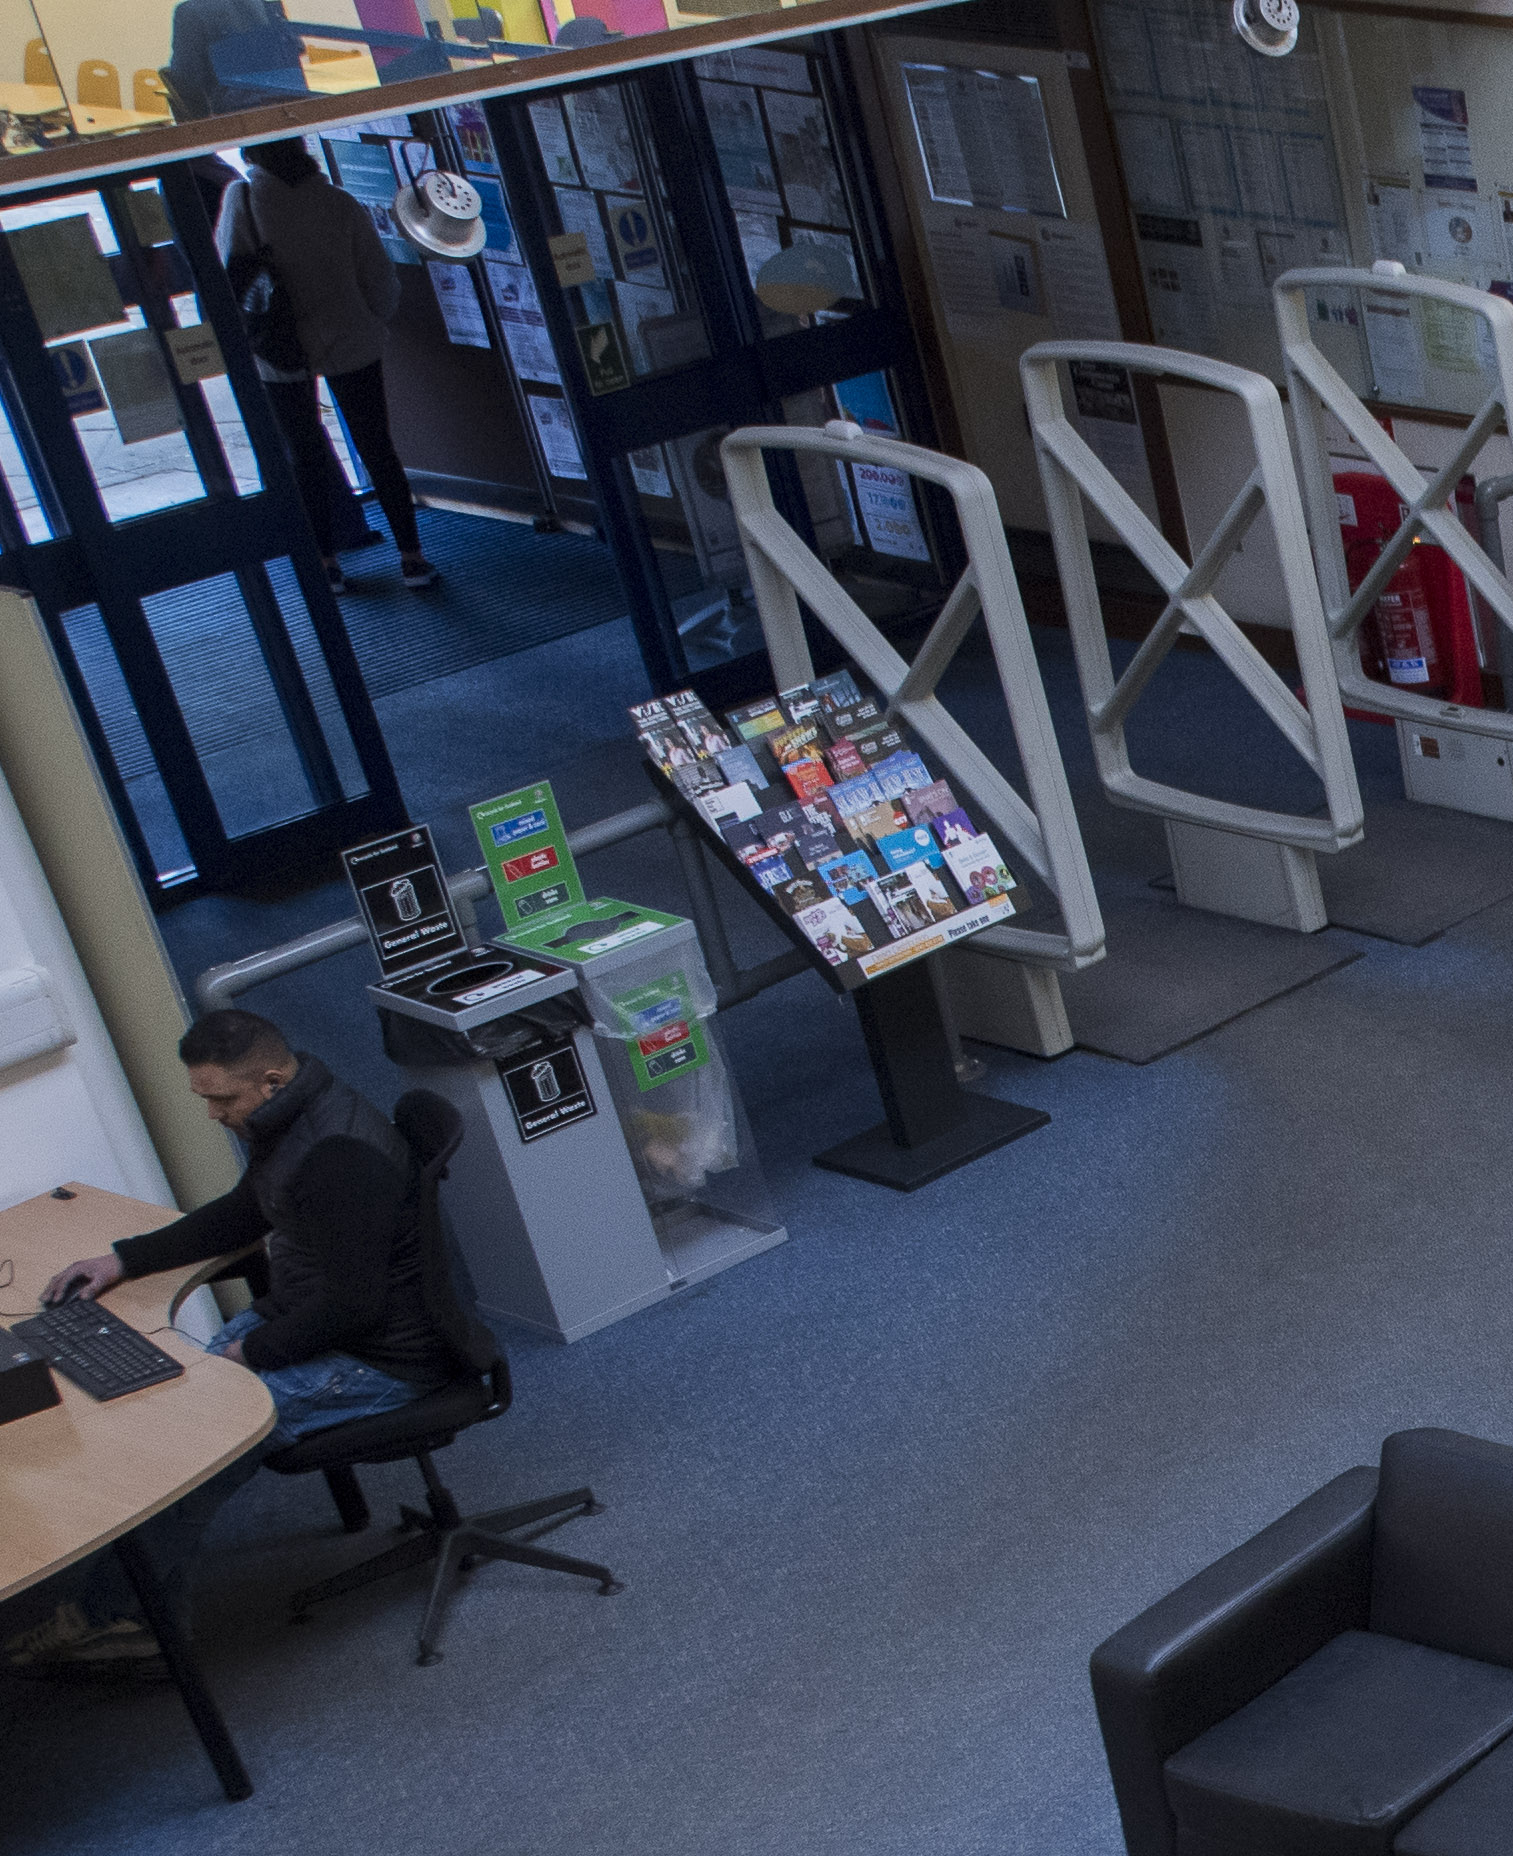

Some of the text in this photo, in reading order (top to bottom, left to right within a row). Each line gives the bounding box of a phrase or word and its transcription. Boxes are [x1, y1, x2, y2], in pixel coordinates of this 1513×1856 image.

[384, 921, 449, 949] General Waste
[947, 921, 967, 938] Please
[967, 918, 980, 931] take
[525, 1100, 586, 1130] General Waste
